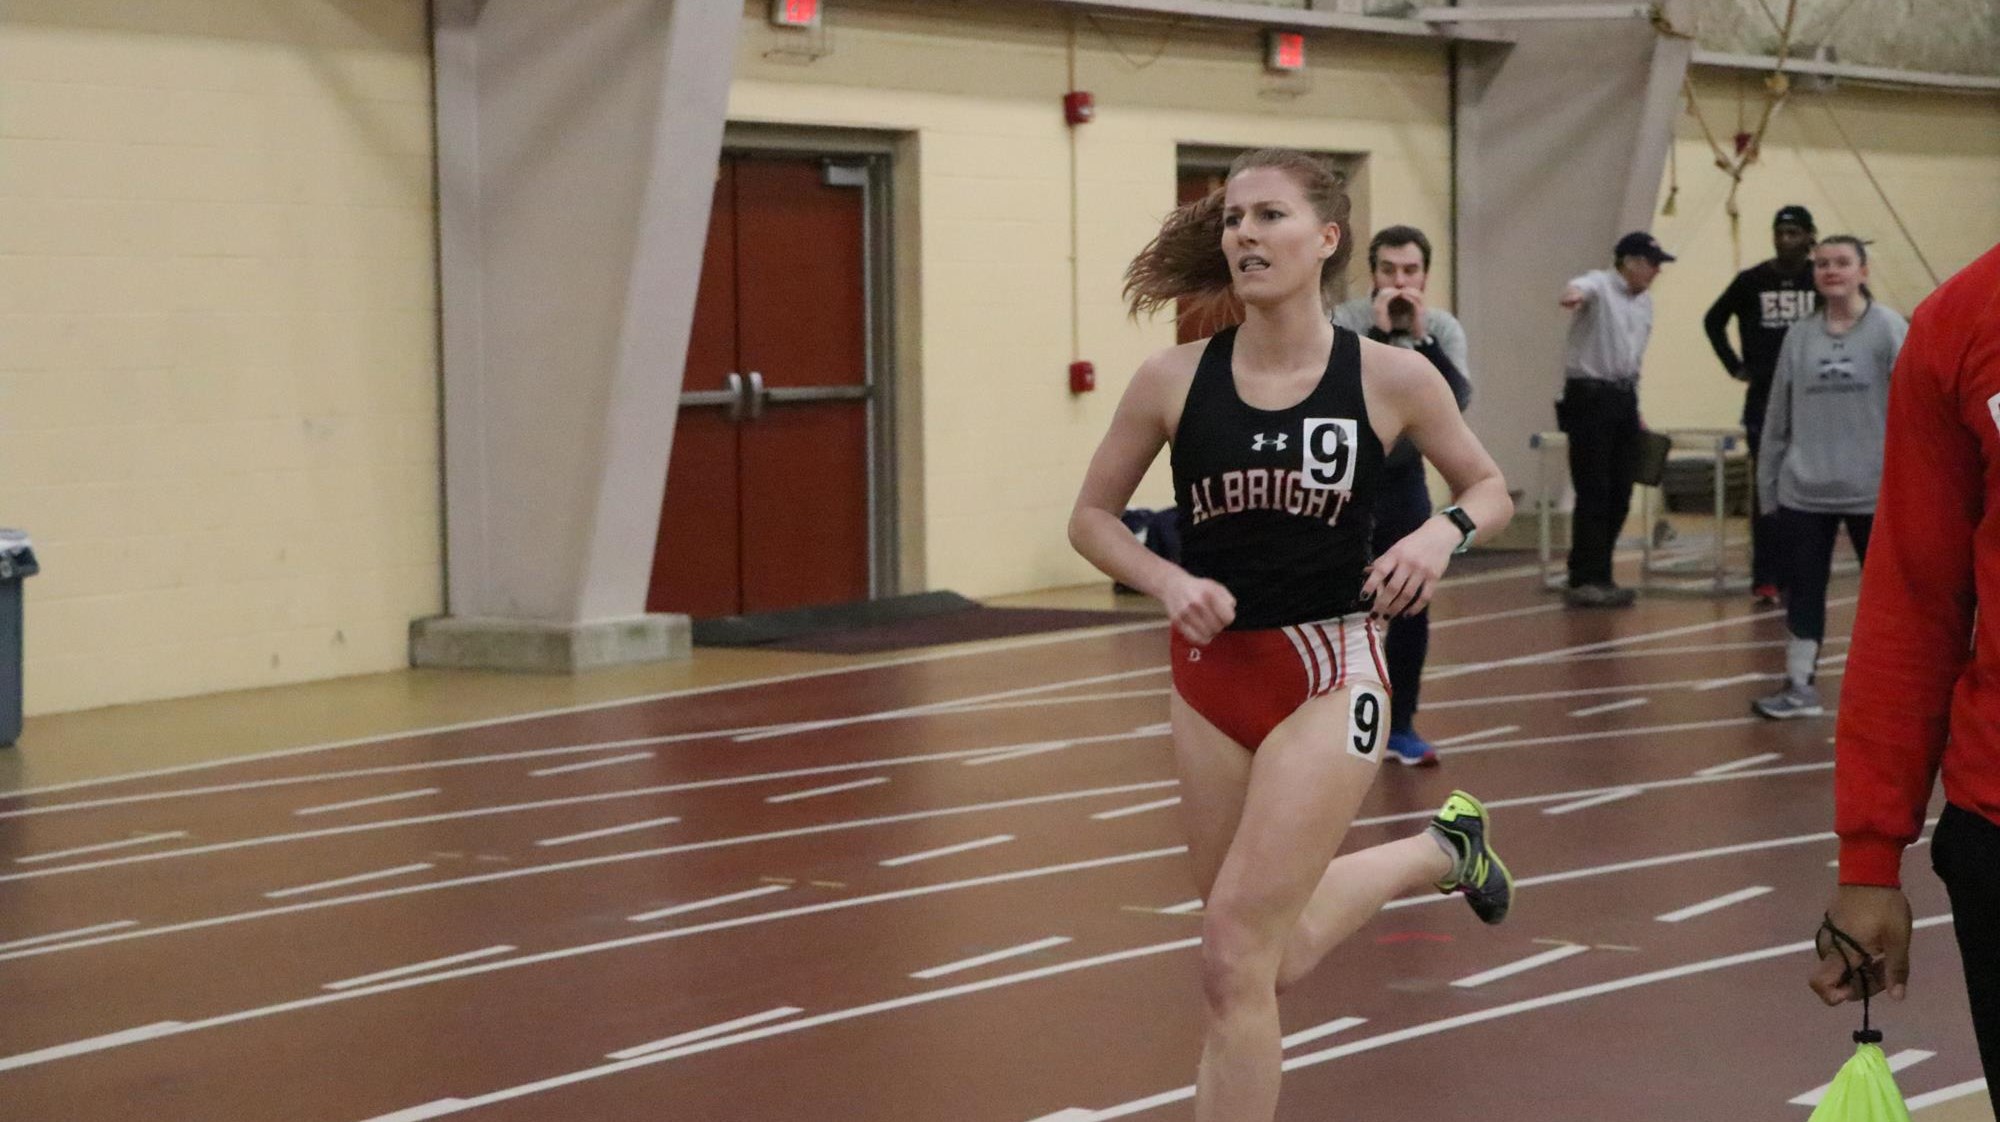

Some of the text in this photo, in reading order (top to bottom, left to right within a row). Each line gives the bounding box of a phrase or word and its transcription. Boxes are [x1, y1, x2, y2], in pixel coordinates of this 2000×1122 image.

[1759, 290, 1816, 319] ESU
[1309, 422, 1350, 485] 9
[1191, 468, 1352, 526] ALBRIGHT
[1353, 692, 1380, 754] 9
